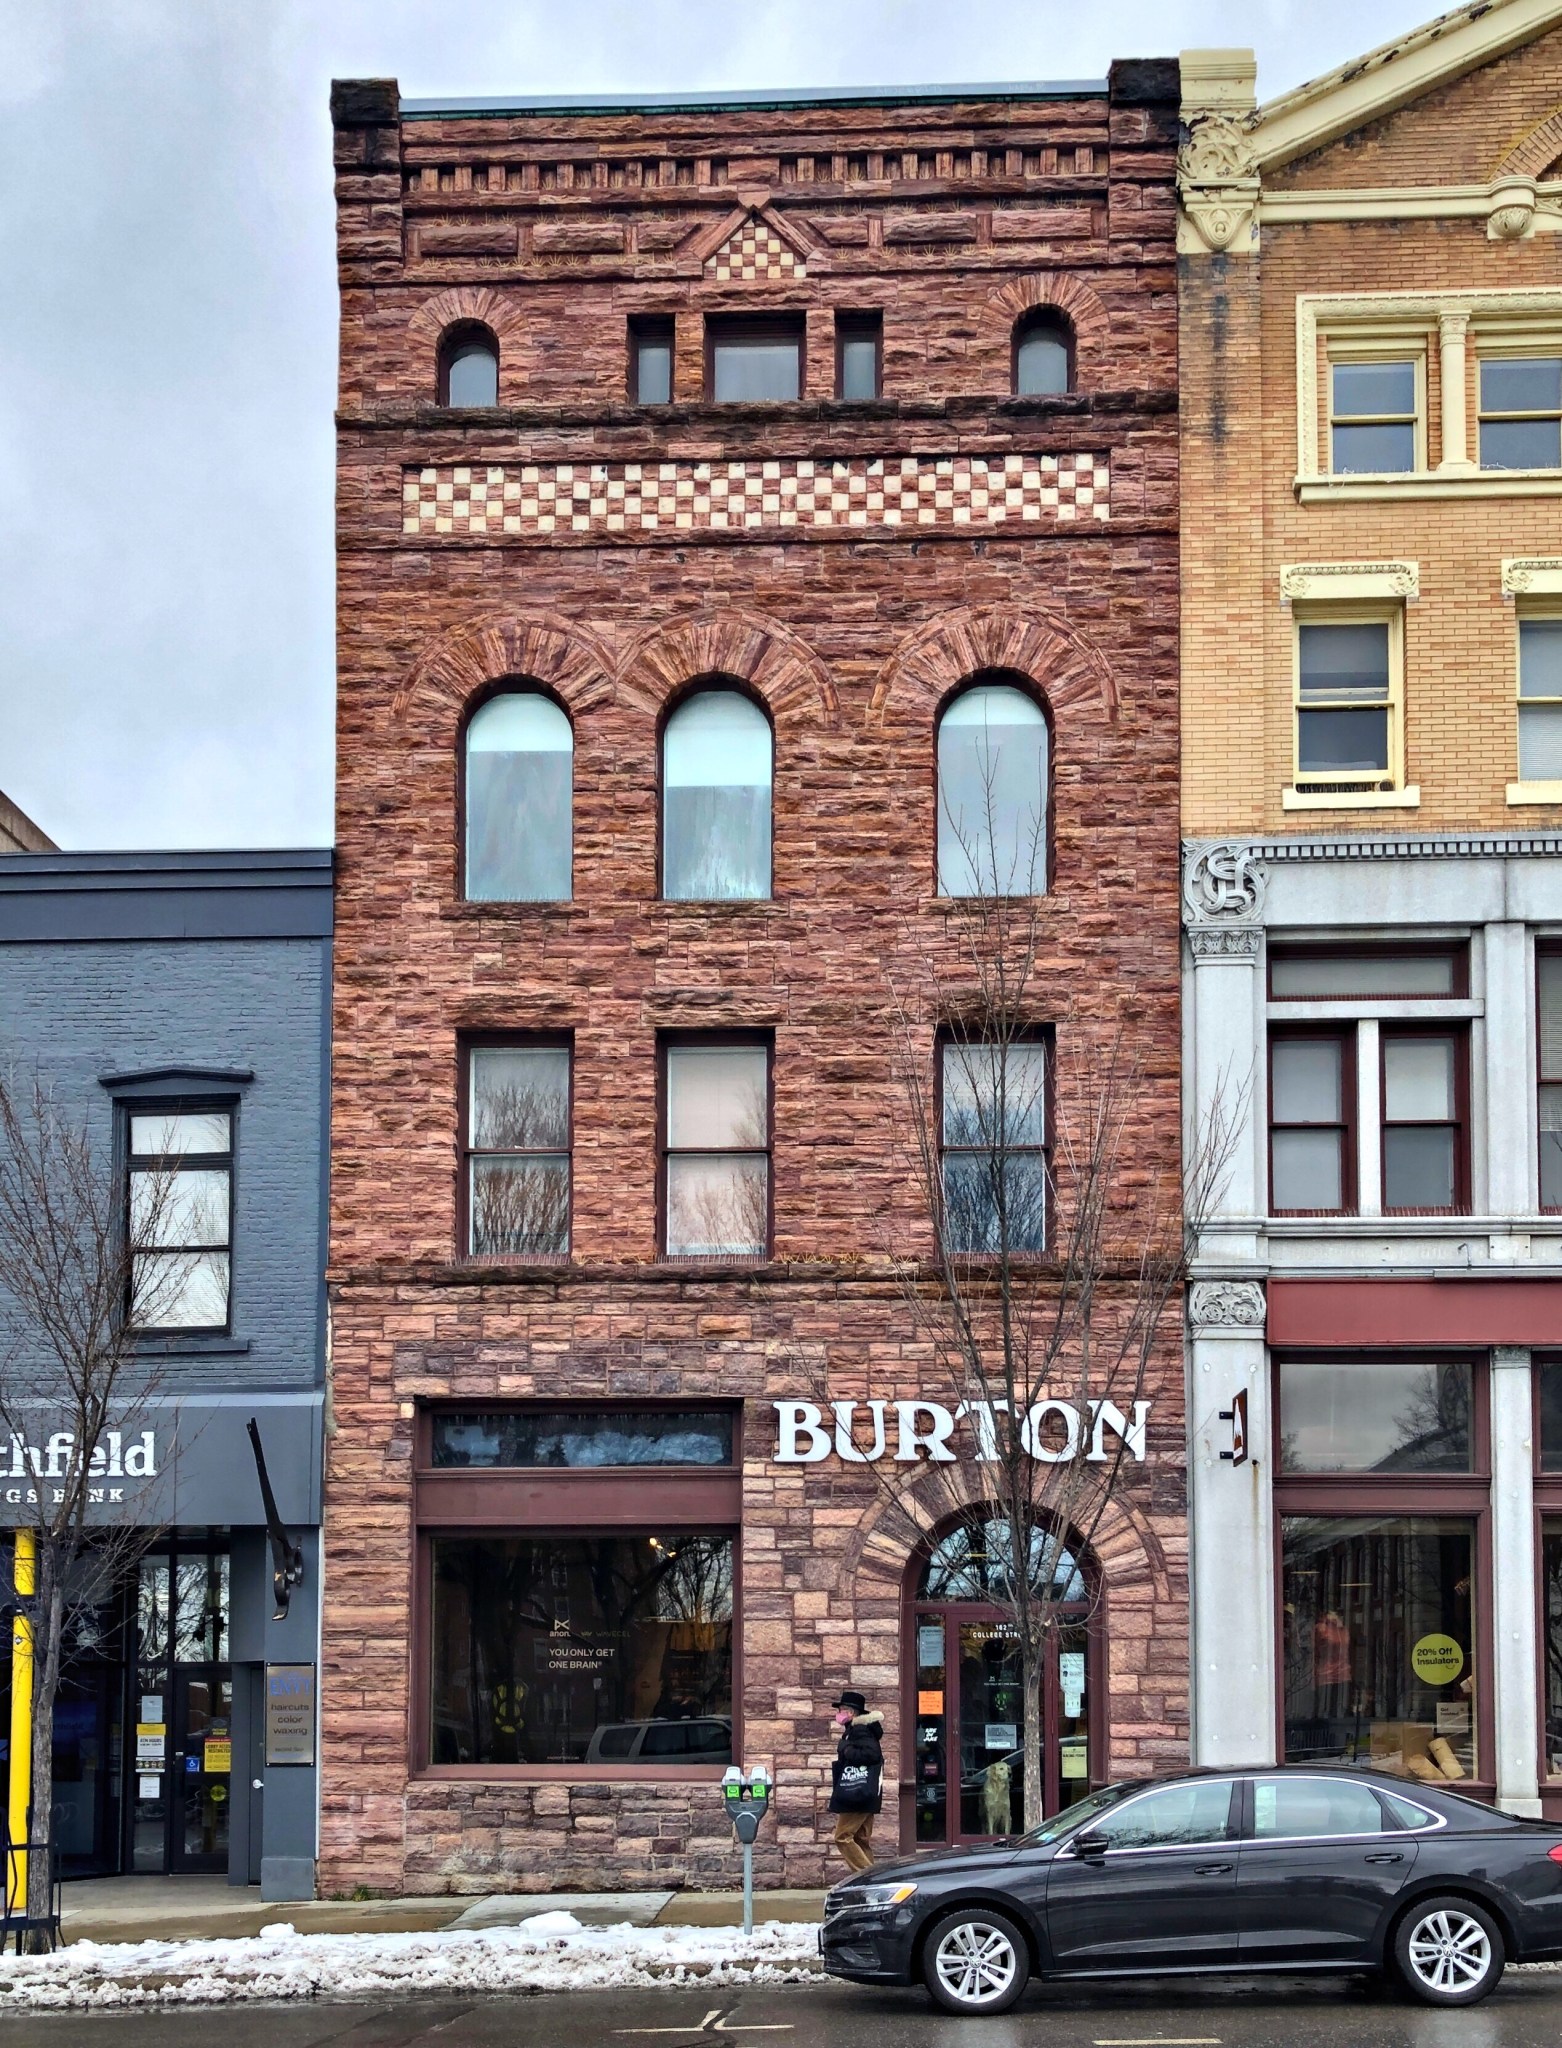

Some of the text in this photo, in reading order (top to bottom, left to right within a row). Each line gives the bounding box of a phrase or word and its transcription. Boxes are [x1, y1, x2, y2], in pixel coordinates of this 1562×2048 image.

[772, 1400, 1152, 1463] BURTON
[53, 1488, 125, 1503] BNK
[1005, 1631, 1021, 1639] STR
[549, 1648, 615, 1657] YOU ONLY GET
[1417, 1647, 1453, 1657] 20% Off
[548, 1660, 569, 1669] ONE
[1417, 1657, 1460, 1666] Insulators
[271, 1703, 310, 1711] haircuts
[277, 1714, 303, 1724] color
[273, 1727, 308, 1736] waxing
[841, 1770, 869, 1781] Market
